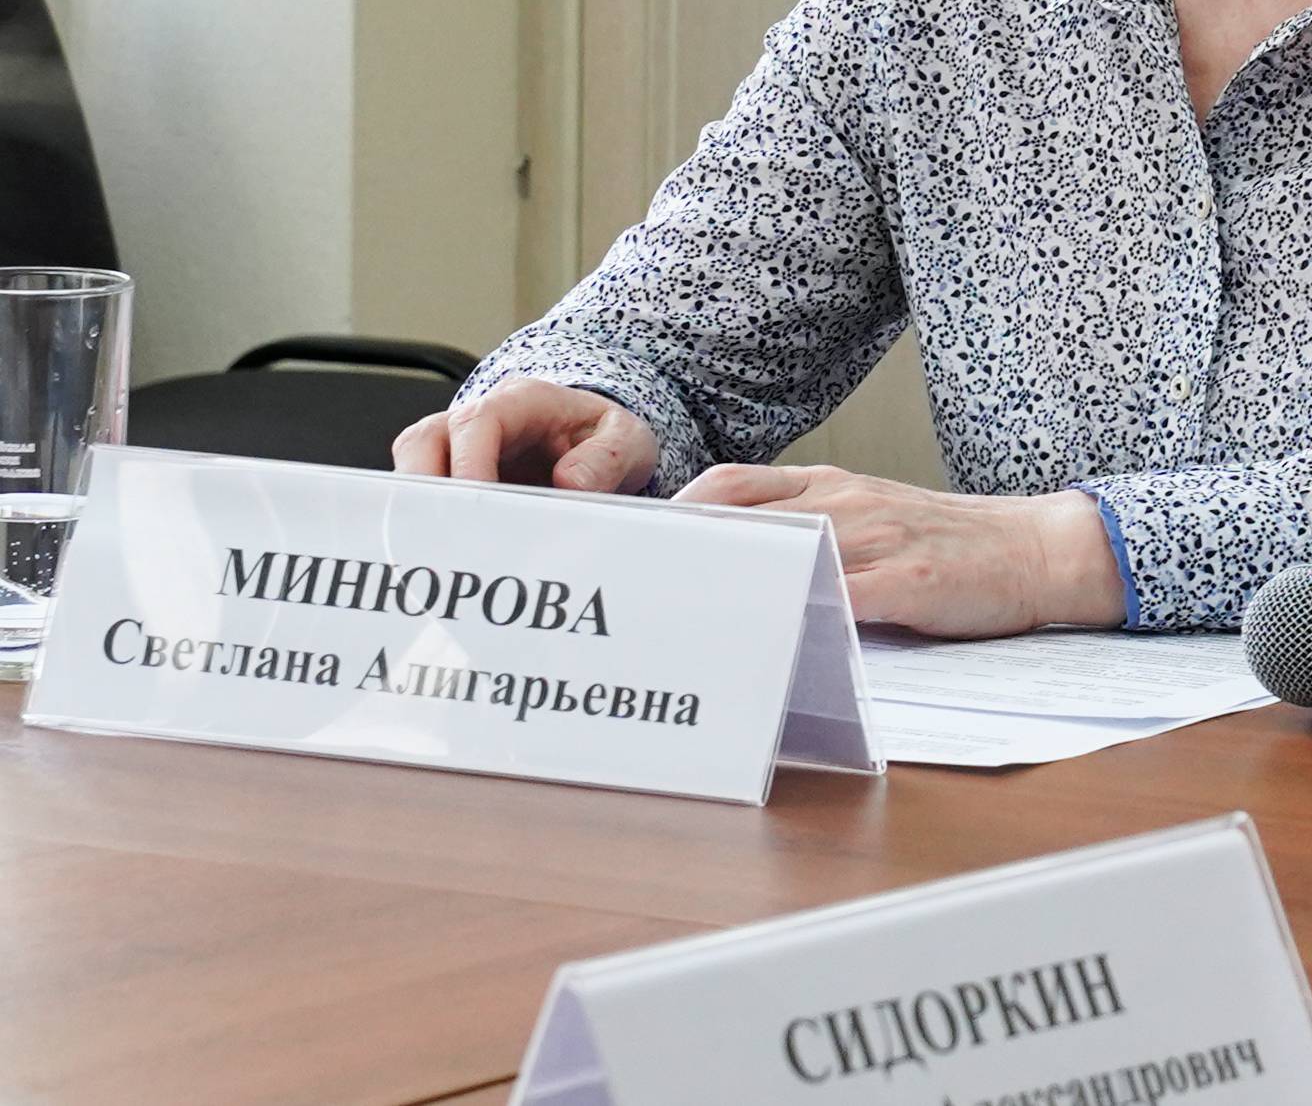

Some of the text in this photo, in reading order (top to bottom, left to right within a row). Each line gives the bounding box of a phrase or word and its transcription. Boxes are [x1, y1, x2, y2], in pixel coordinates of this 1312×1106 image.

[216, 547, 611, 637] МИНЮРОВА
[103, 617, 702, 727] Светлана Алигарьевна
[782, 952, 1126, 1086] СИДОРКИН
[943, 1037, 1265, 1106] сандрович
